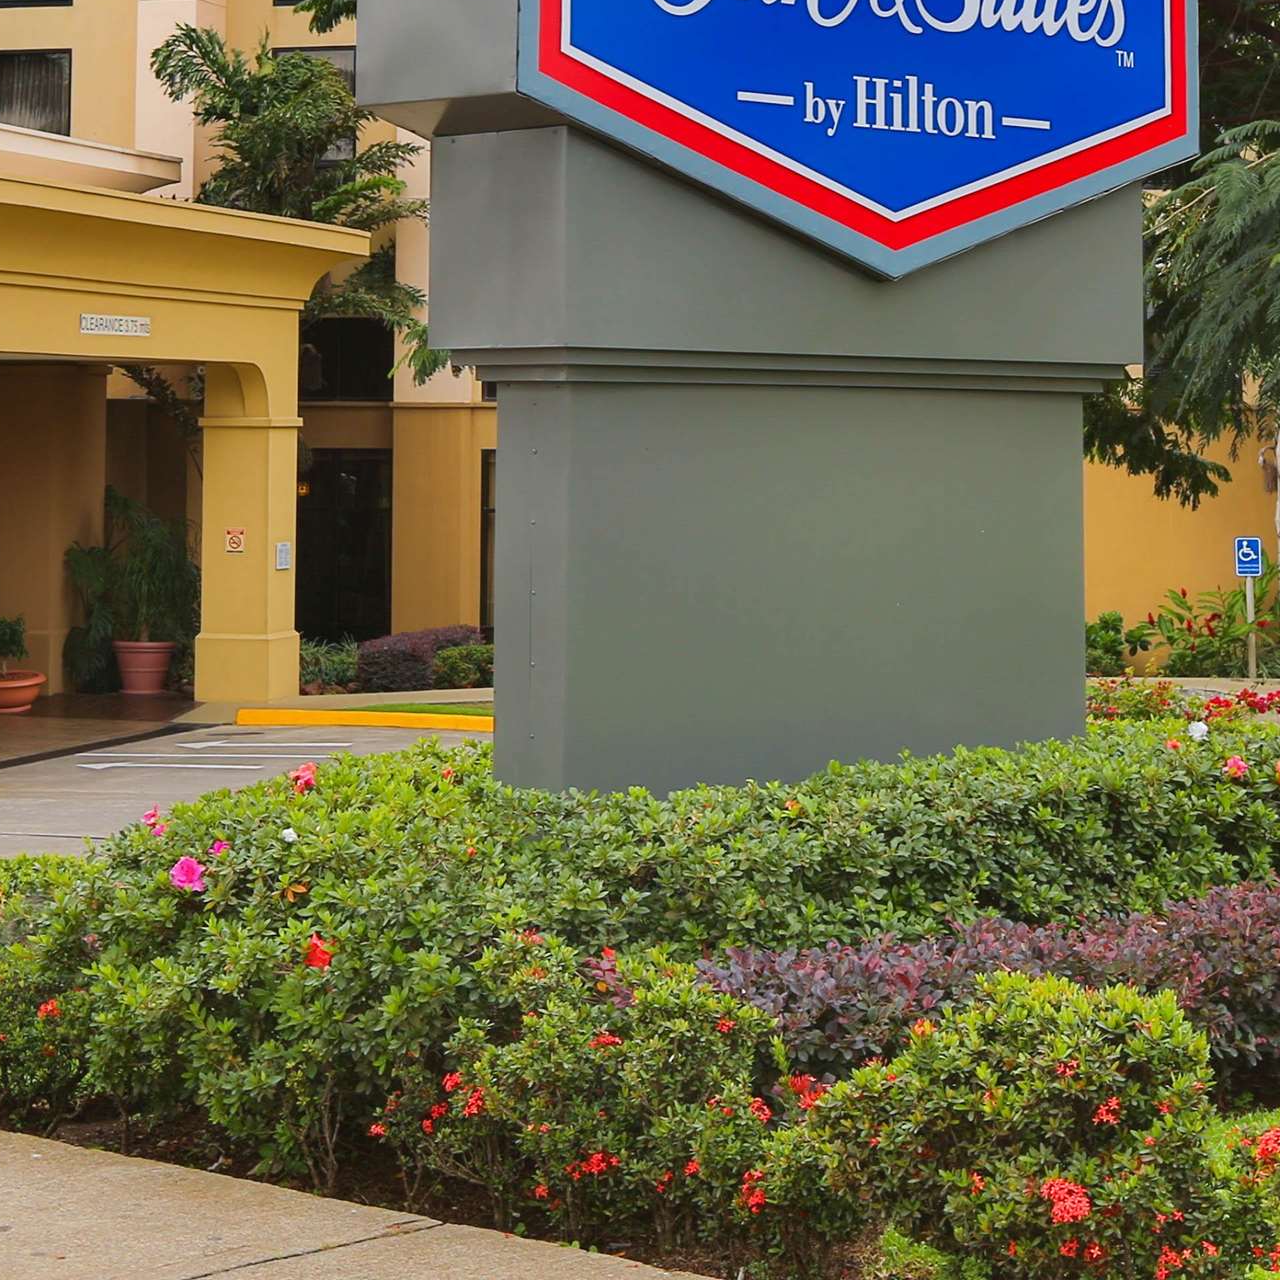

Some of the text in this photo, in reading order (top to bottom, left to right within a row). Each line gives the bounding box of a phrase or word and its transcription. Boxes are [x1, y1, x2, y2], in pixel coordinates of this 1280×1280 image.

[1115, 50, 1134, 68] TM
[804, 75, 996, 139] by Hilton
[80, 316, 123, 333] CLEARANCE
